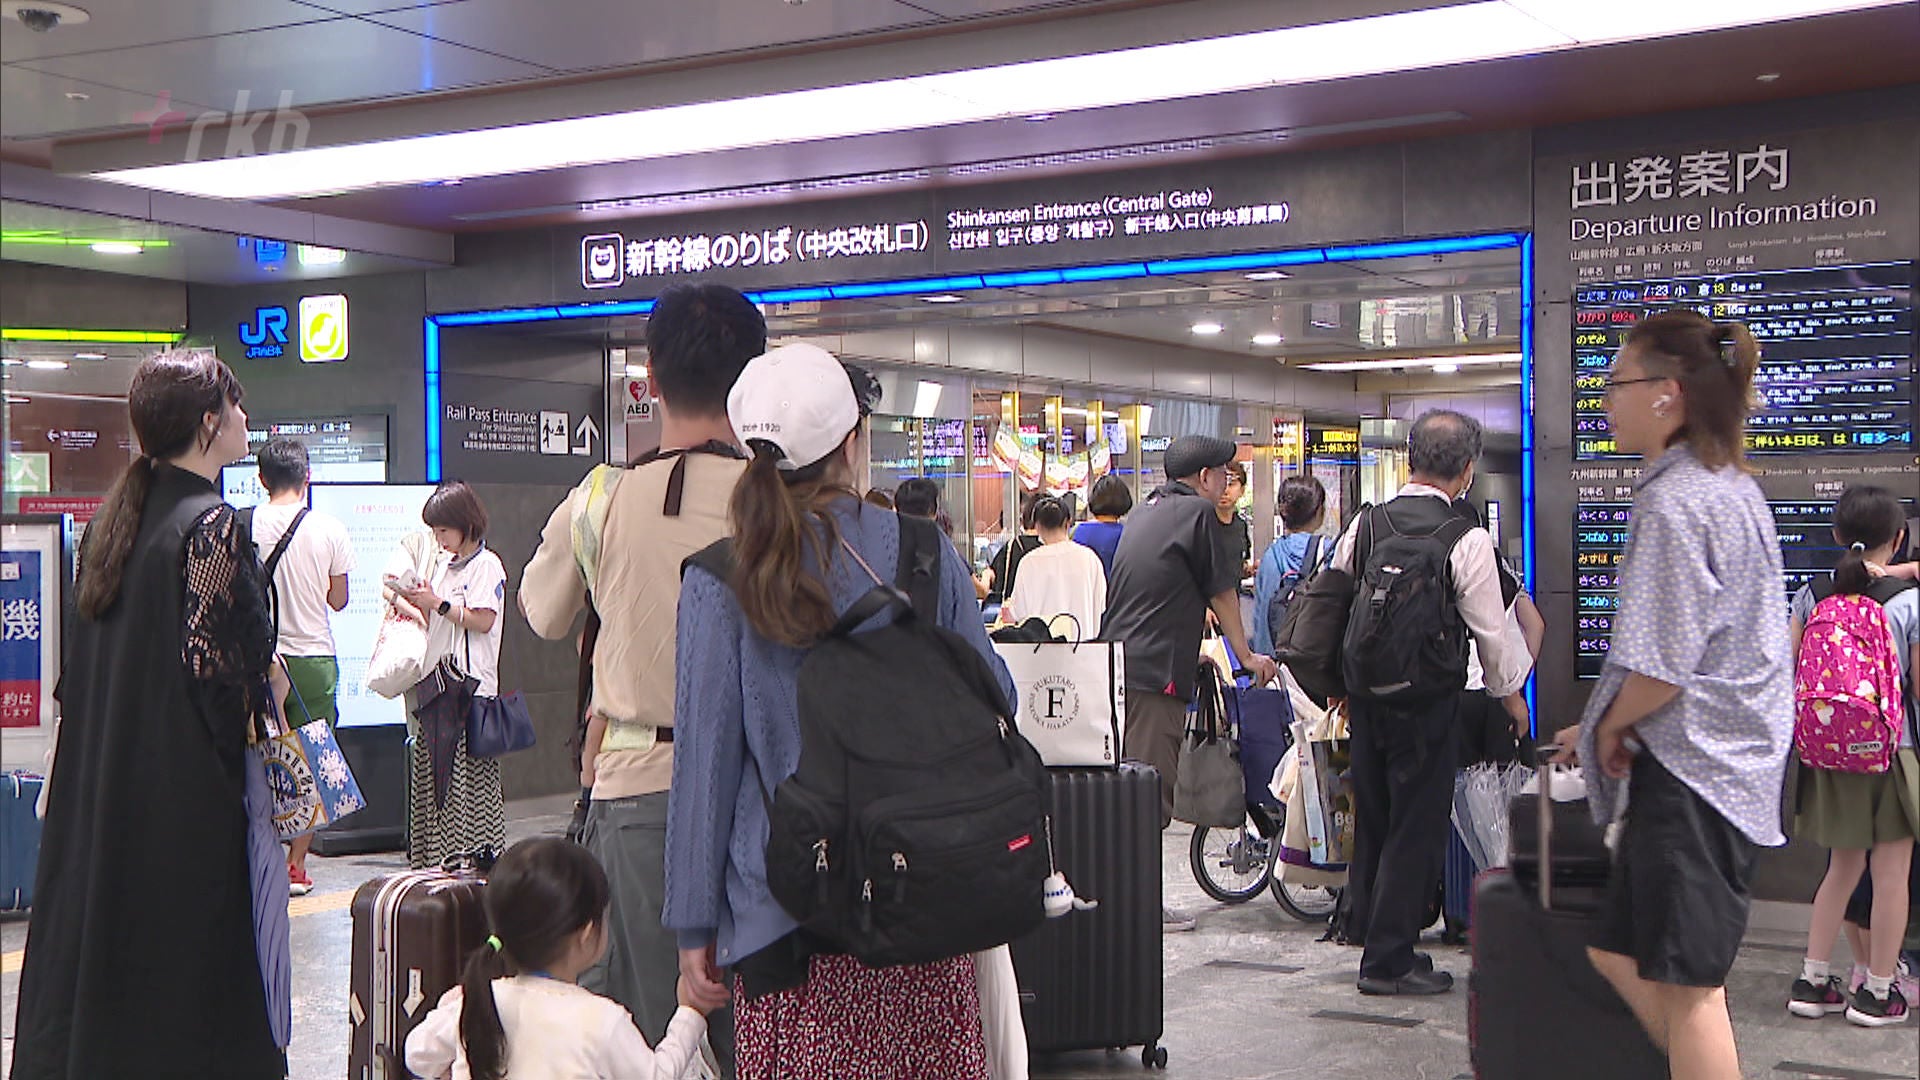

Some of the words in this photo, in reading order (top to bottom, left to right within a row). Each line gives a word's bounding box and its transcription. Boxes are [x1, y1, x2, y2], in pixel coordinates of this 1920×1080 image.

[1571, 144, 1790, 210] 出発案内
[947, 204, 1031, 228] Shinkansen
[1034, 197, 1101, 220] Entrance
[1102, 193, 1165, 217] (Central
[1169, 187, 1213, 210] Gate)
[1570, 213, 1702, 244] Departure
[1710, 194, 1878, 229] Information
[949, 229, 991, 250] 신칸센
[1577, 311, 1607, 323] ひかり
[239, 306, 289, 345] JR
[1576, 333, 1607, 345] のぞみ
[1577, 355, 1608, 367] つばめ
[446, 405, 467, 421] Rail
[469, 406, 491, 423] Pass
[493, 408, 537, 424] Entrance
[627, 403, 650, 415] AED
[1577, 421, 1608, 431] さくら
[1579, 511, 1608, 521] さくら
[1579, 533, 1608, 543] つばめ
[1578, 553, 1608, 565] みずほ
[1579, 575, 1608, 586] さくら
[1579, 597, 1609, 607] つばめ
[1579, 618, 1609, 629] さくら
[1579, 640, 1609, 651] さくら
